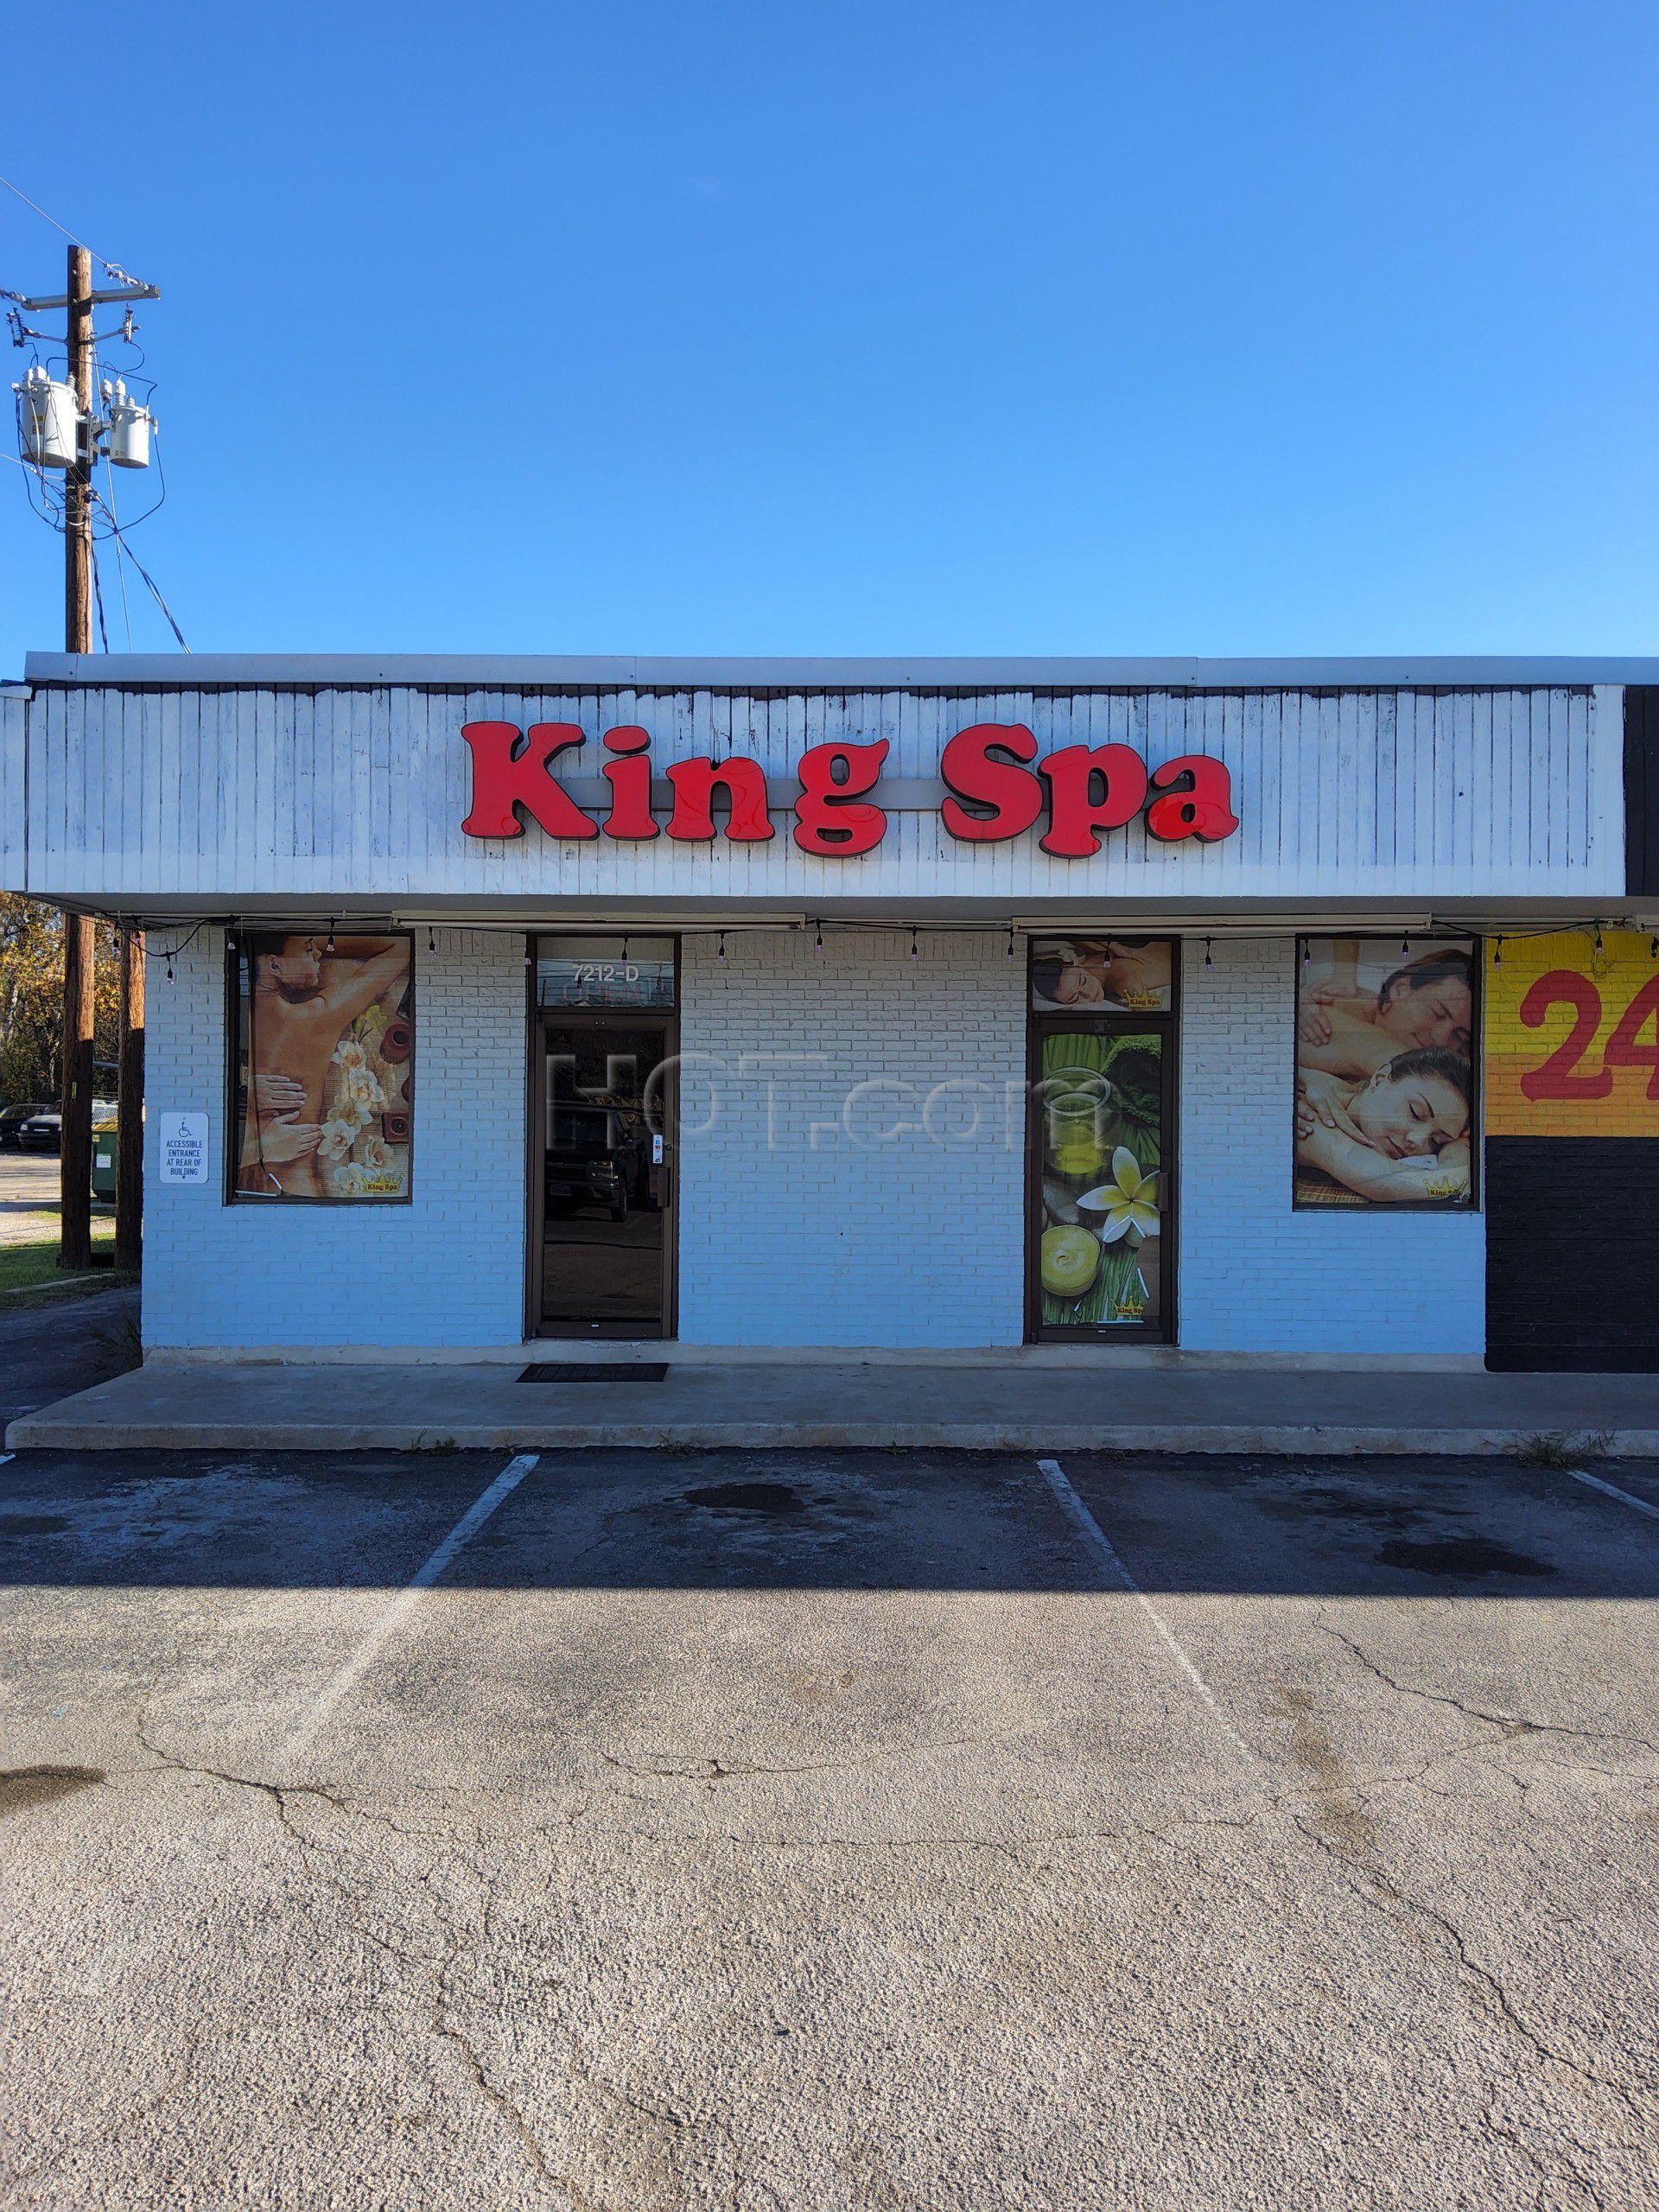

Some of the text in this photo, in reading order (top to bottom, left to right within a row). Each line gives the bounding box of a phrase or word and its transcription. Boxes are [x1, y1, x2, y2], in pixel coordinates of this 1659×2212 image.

[462, 721, 1241, 859] King Spa
[571, 964, 639, 982] 7212-D
[563, 982, 642, 1002] OPEN
[1519, 969, 1659, 1103] 24
[166, 1140, 203, 1148] ACCESSIBLE
